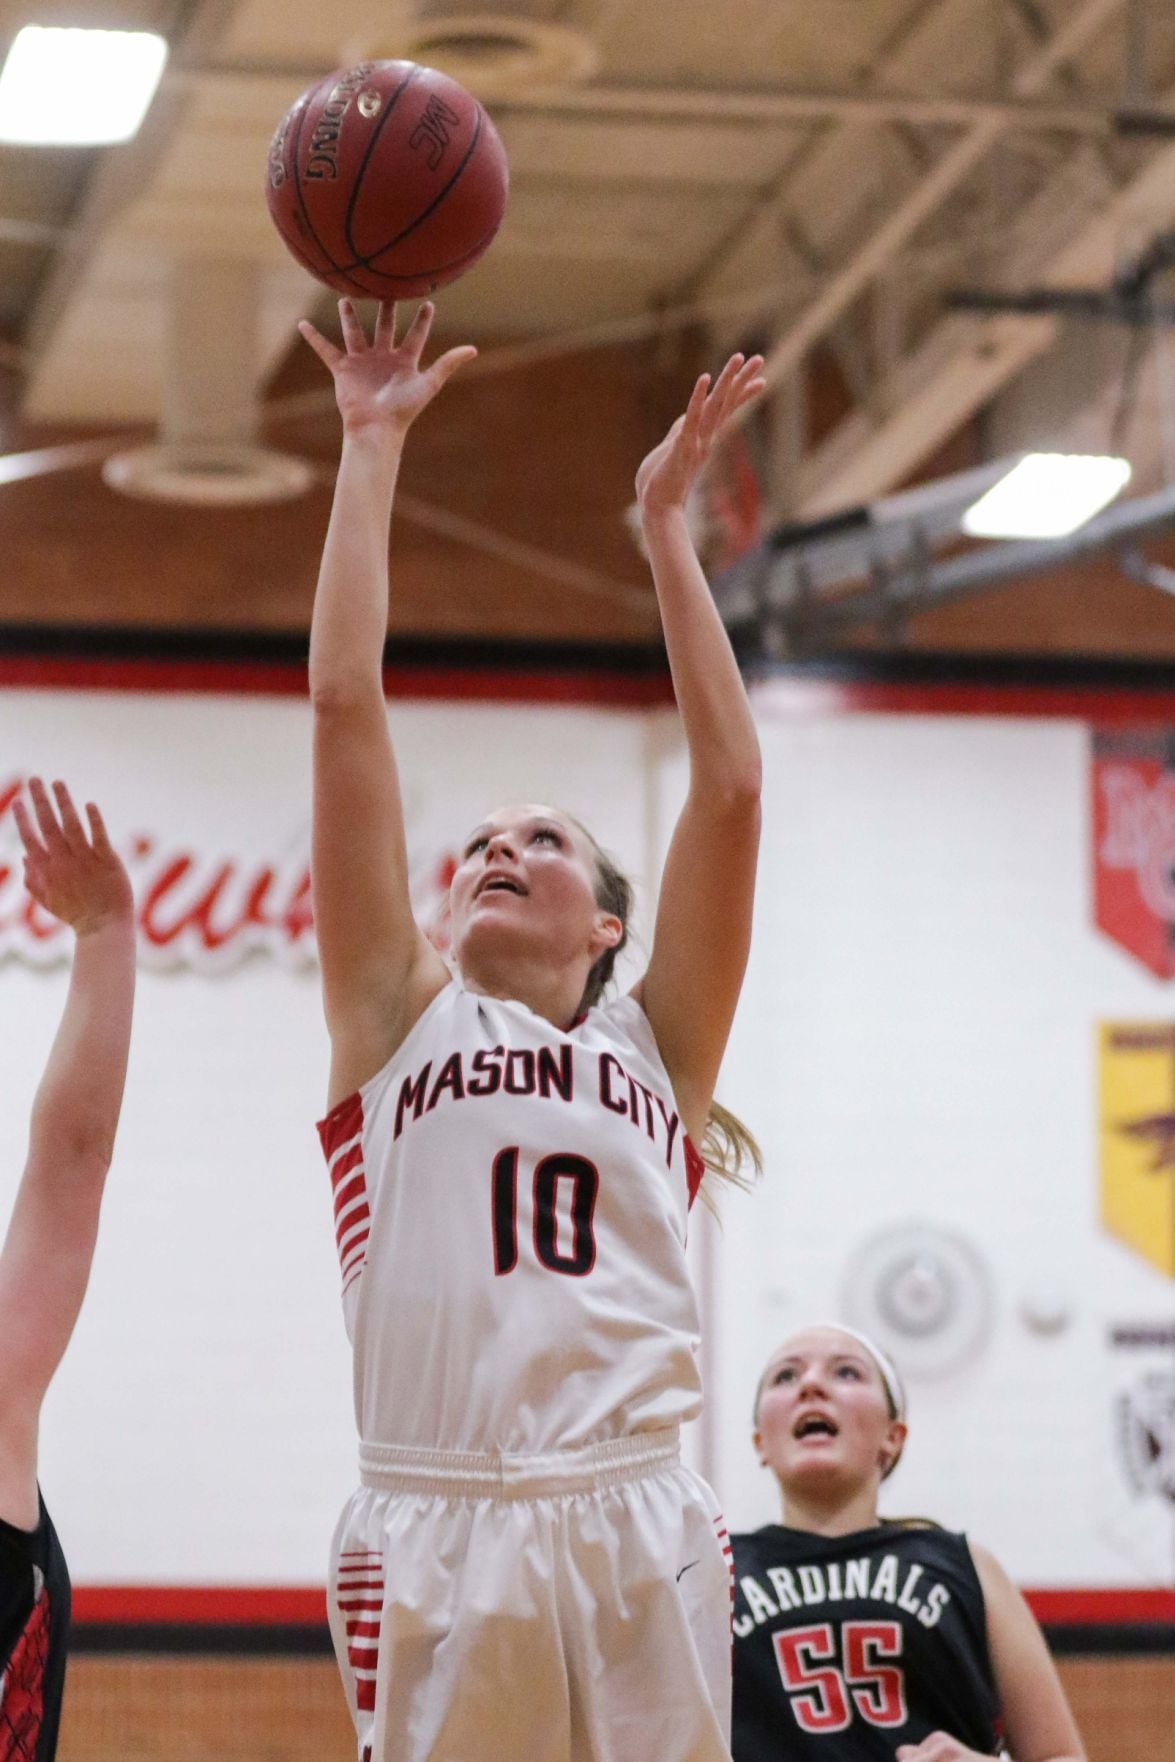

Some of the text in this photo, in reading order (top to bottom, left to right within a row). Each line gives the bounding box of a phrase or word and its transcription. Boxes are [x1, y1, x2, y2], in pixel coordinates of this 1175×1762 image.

[303, 63, 375, 181] LDING
[393, 1043, 679, 1170] MASON CITY
[491, 1146, 599, 1277] 10
[771, 1620, 908, 1734] 55
